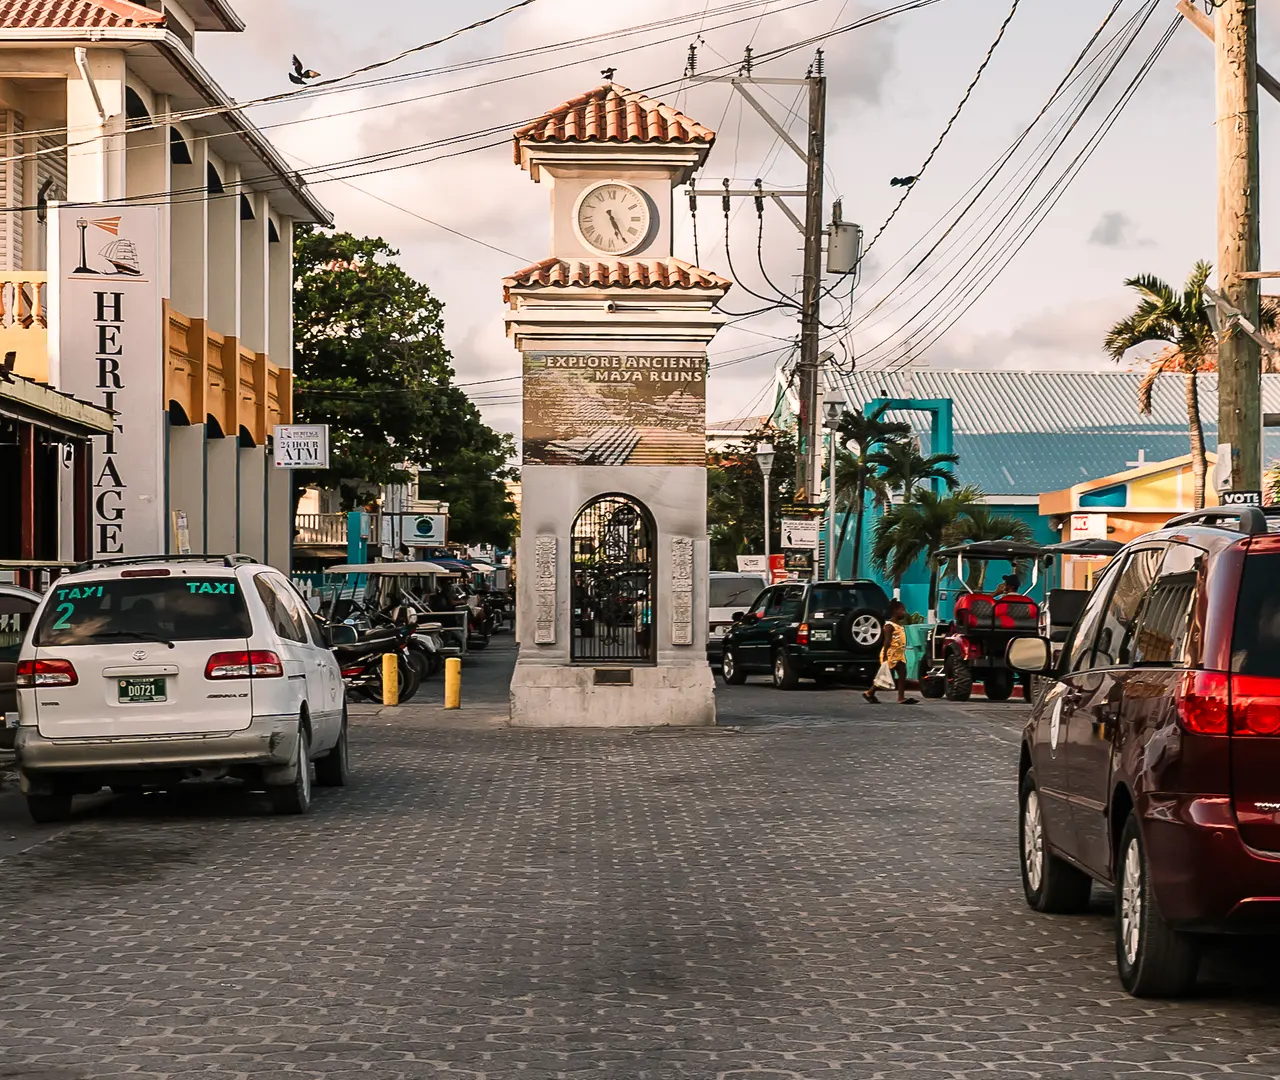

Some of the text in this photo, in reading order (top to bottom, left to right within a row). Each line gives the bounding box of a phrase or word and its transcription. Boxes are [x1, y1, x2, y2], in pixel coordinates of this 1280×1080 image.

[546, 356, 703, 368] EXPLORE ANCIENT
[595, 371, 702, 382] MAYA RUINS
[93, 291, 127, 554] HERITAGE
[280, 441, 290, 449] 24
[282, 448, 319, 460] ATM
[1224, 493, 1259, 504] VOTE
[57, 586, 104, 601] TAXI
[186, 582, 235, 595] TAXI
[52, 602, 75, 630] 2
